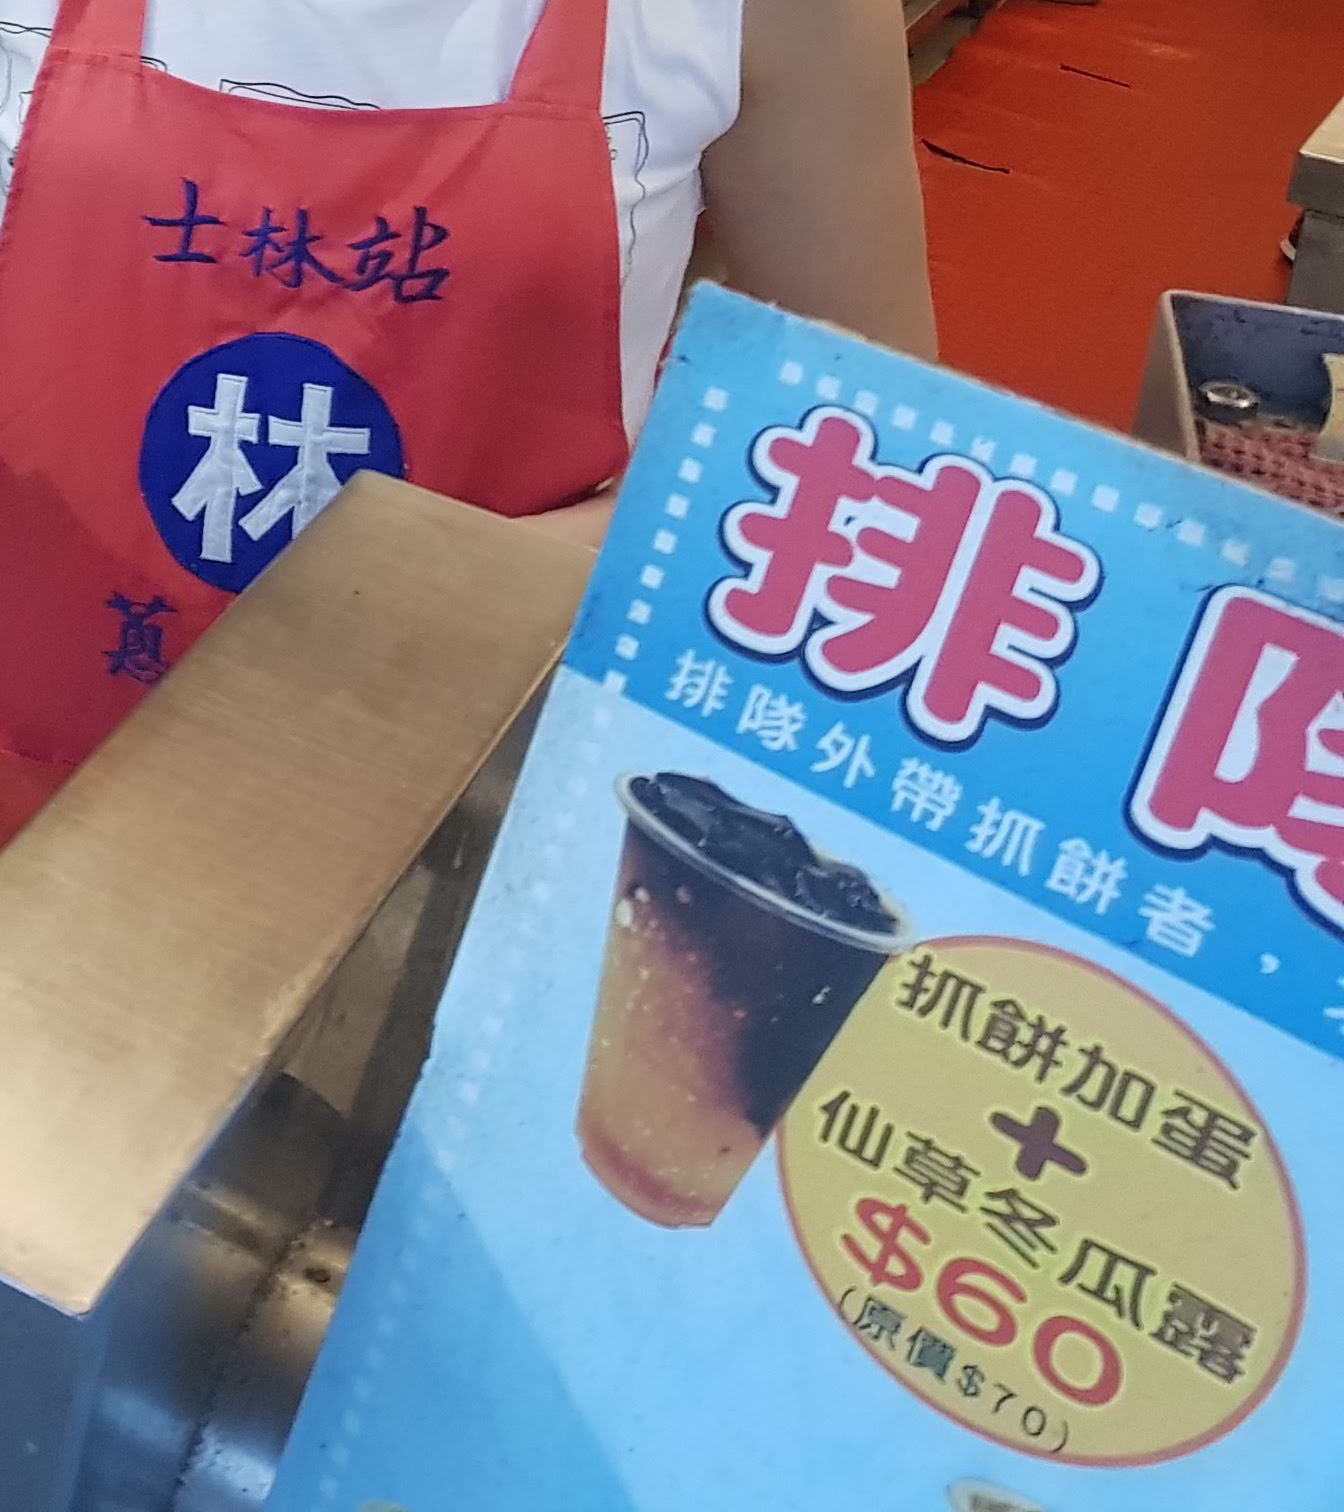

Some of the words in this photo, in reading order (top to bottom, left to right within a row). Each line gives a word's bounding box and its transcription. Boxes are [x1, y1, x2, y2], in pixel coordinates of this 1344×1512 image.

[139, 176, 451, 305] 士林站
[170, 372, 371, 565] 林
[665, 649, 1344, 1036] 排隊外帶抓餅者，
[895, 955, 1257, 1190] 抓餅加蛋
[816, 1090, 1257, 1384] 仙草冬瓜露
[842, 1197, 1124, 1406] $60
